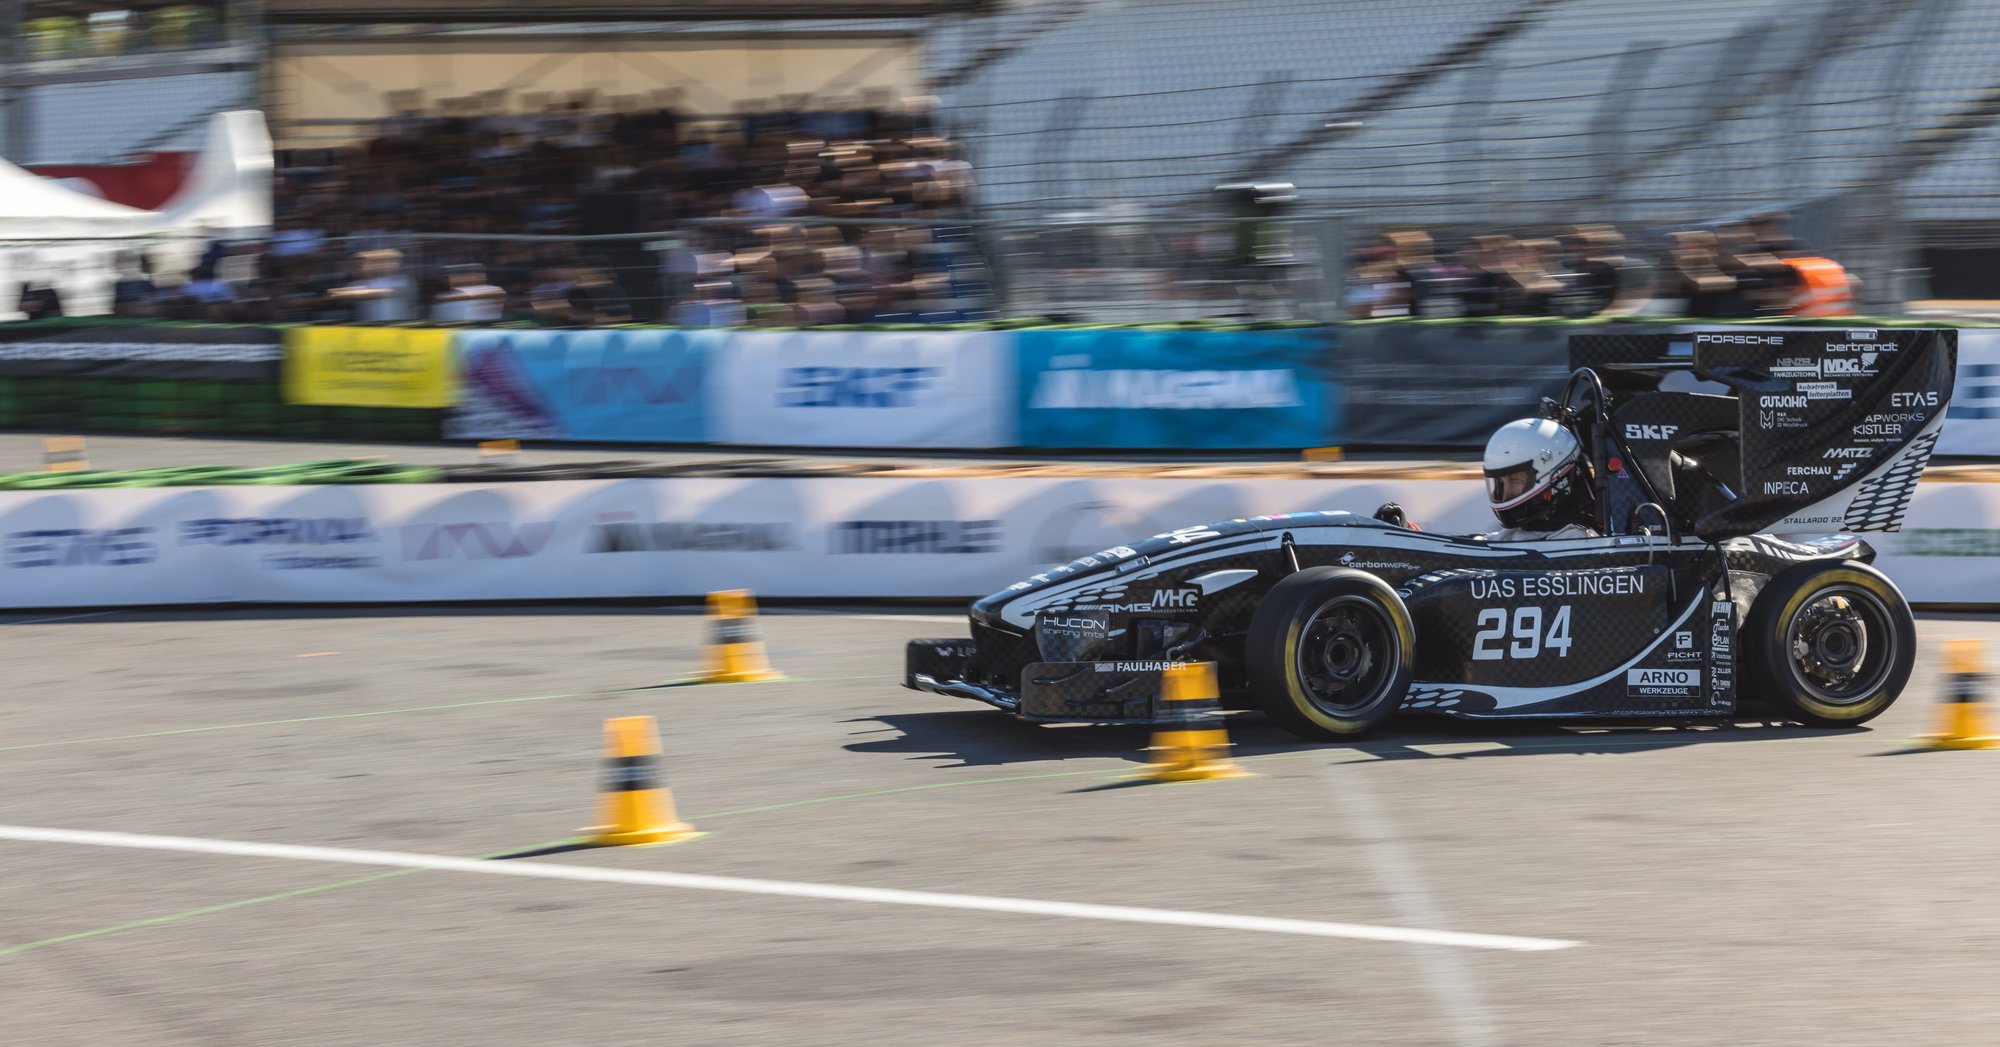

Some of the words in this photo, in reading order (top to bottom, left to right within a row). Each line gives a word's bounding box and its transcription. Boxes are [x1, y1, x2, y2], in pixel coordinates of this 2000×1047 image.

[1697, 334, 1784, 345] PORSCHE
[1826, 342, 1899, 352] bertrandt
[1823, 358, 1859, 373] MDG
[1809, 391, 1850, 399] leiterplatten
[1891, 391, 1938, 407] ETAS
[1759, 395, 1808, 408] GUTJAHR
[1864, 412, 1925, 423] APWORKS
[1625, 423, 1679, 440] SKF
[1852, 424, 1902, 435] KISTLER
[1787, 466, 1832, 475] FERCHAU
[1764, 481, 1809, 495] INPECA
[1783, 516, 1829, 525] STALLARDO
[1470, 578, 1516, 599] UAS
[1522, 575, 1644, 597] ESSLINGEN
[1098, 603, 1152, 613] AMG
[1043, 616, 1106, 630] HUCON
[1472, 605, 1573, 661] 294
[1667, 651, 1703, 659] FICHT
[1116, 661, 1186, 672] FAULHABER
[1639, 671, 1689, 684] ARNO
[1639, 687, 1689, 695] WERKZEUGE
